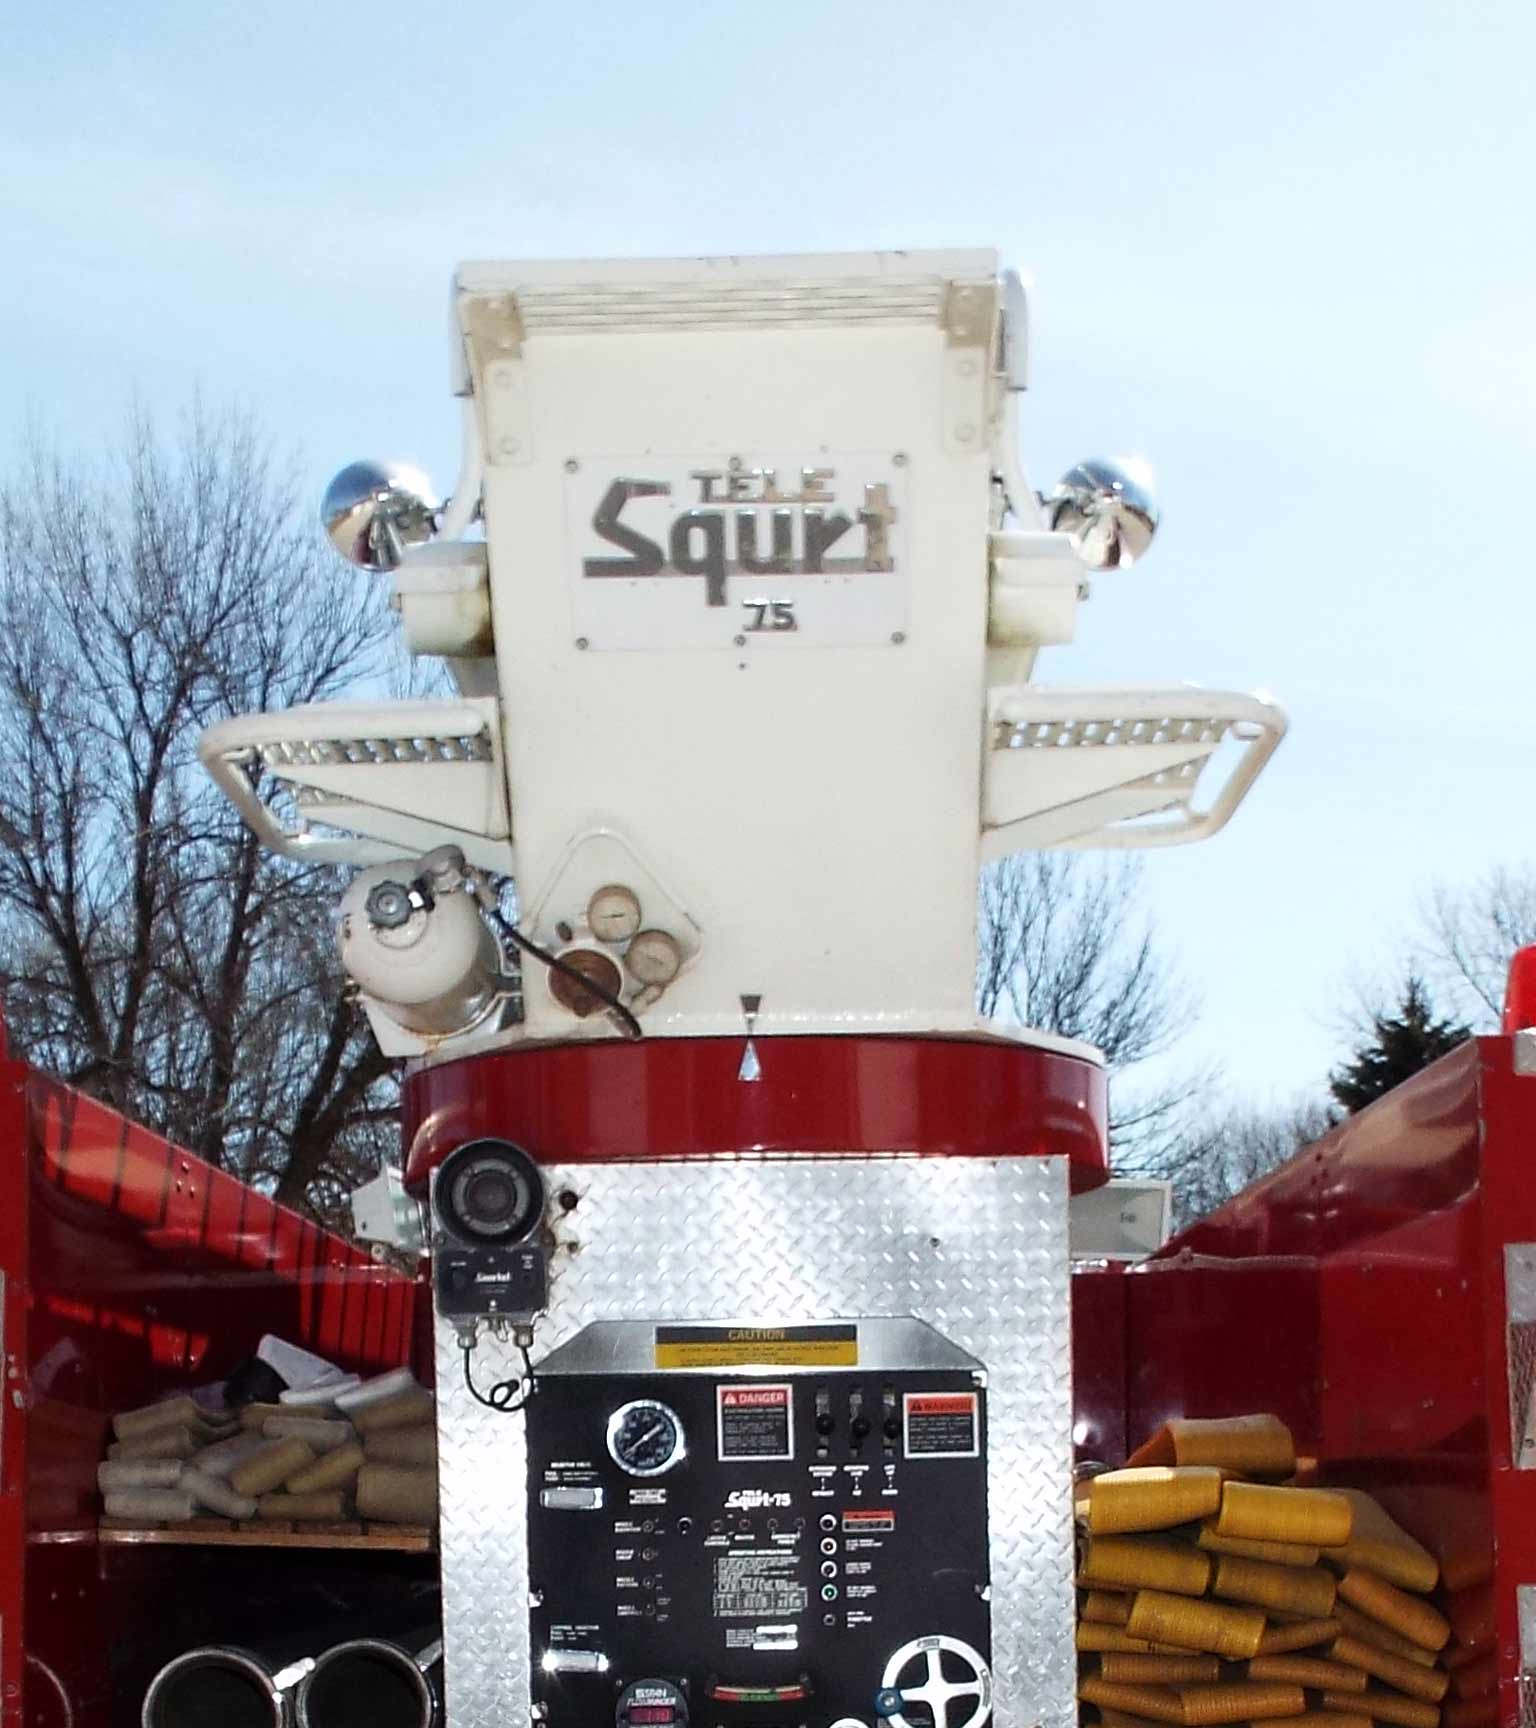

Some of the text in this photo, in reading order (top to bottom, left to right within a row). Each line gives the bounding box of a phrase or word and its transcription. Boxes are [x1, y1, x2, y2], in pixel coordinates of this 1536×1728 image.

[690, 466, 834, 503] TELE
[742, 599, 798, 631] 75
[728, 1329, 785, 1341] CAUTION
[739, 1391, 784, 1404] DANGER
